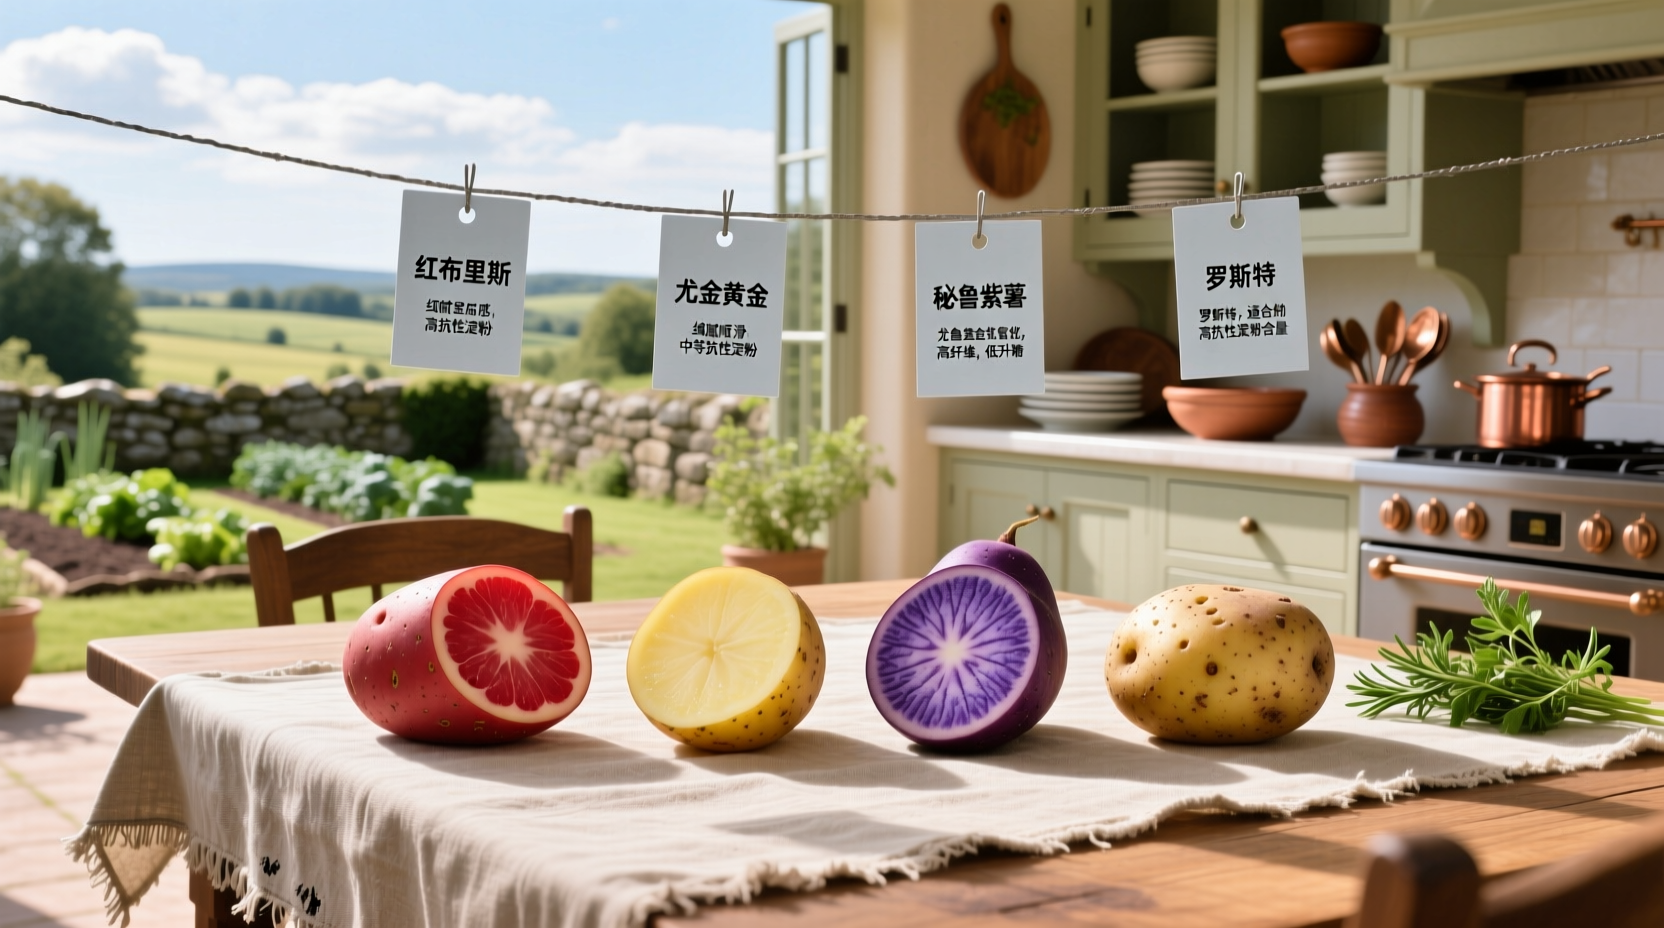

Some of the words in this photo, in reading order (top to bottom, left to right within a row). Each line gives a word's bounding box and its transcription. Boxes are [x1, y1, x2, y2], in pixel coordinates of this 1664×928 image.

[414, 254, 512, 287] 红布里斯
[1206, 261, 1276, 291] 罗斯特
[674, 278, 769, 308] 尤金黄金
[932, 282, 1027, 311] 秘鲁紫薯
